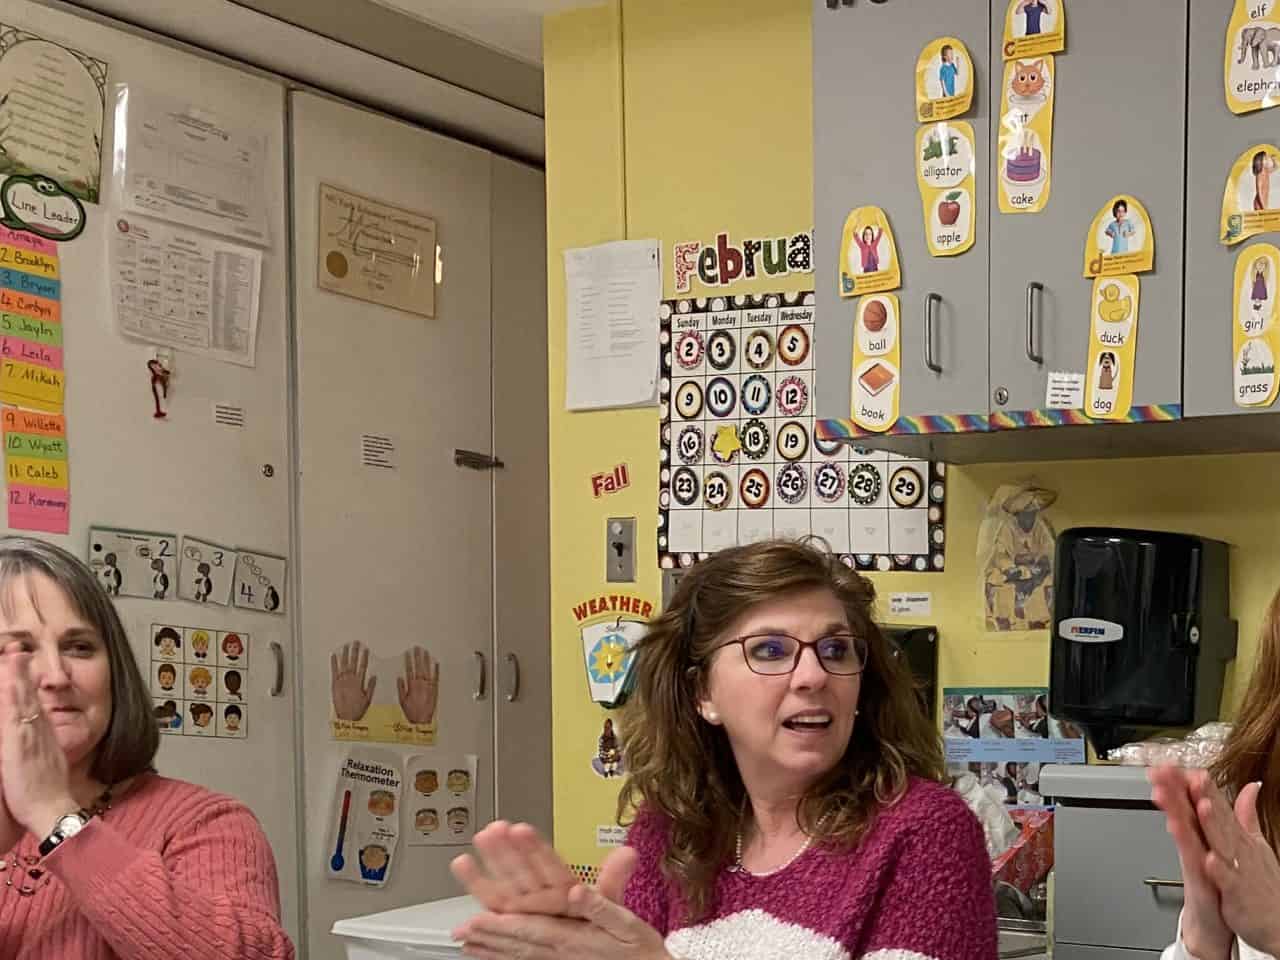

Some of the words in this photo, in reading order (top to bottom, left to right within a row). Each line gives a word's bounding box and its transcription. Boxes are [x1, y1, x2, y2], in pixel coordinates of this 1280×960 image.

[1250, 5, 1267, 19] elf
[924, 166, 962, 179] alligator
[1011, 194, 1034, 205] cake
[11, 191, 38, 215] Line
[43, 202, 78, 226] Leader
[936, 232, 961, 244] apple
[677, 317, 699, 329] Sunday
[712, 315, 736, 327] Monday
[747, 312, 772, 325] Tuesday
[780, 310, 812, 322] Wednesday
[1245, 318, 1264, 332] girl
[869, 339, 886, 351] ball
[1100, 331, 1125, 345] duck
[685, 342, 694, 357] 2
[716, 343, 725, 356] 3
[754, 344, 763, 357] 4
[788, 336, 797, 352] 5
[685, 393, 693, 406] 9
[714, 389, 727, 405] 10
[751, 386, 761, 402] 11
[785, 389, 797, 405] 12
[1239, 383, 1268, 397] grass
[861, 404, 885, 420] book
[1093, 398, 1112, 413] dog
[682, 436, 696, 452] 16
[748, 431, 760, 446] 18
[785, 433, 798, 448] 19
[27, 465, 58, 479] Caleb
[592, 464, 628, 497] Fall
[678, 478, 692, 492] 23
[708, 483, 725, 499] 24
[746, 479, 762, 497] 25
[782, 474, 799, 491] 26
[820, 474, 836, 490] 27
[854, 477, 872, 493] 28
[895, 479, 915, 497] 29
[158, 540, 172, 557] 2
[212, 552, 225, 567] 3
[240, 582, 255, 604] 4
[573, 595, 653, 621] WEATHER
[347, 759, 394, 777] Relaxation
[341, 768, 400, 788] Thermometer
